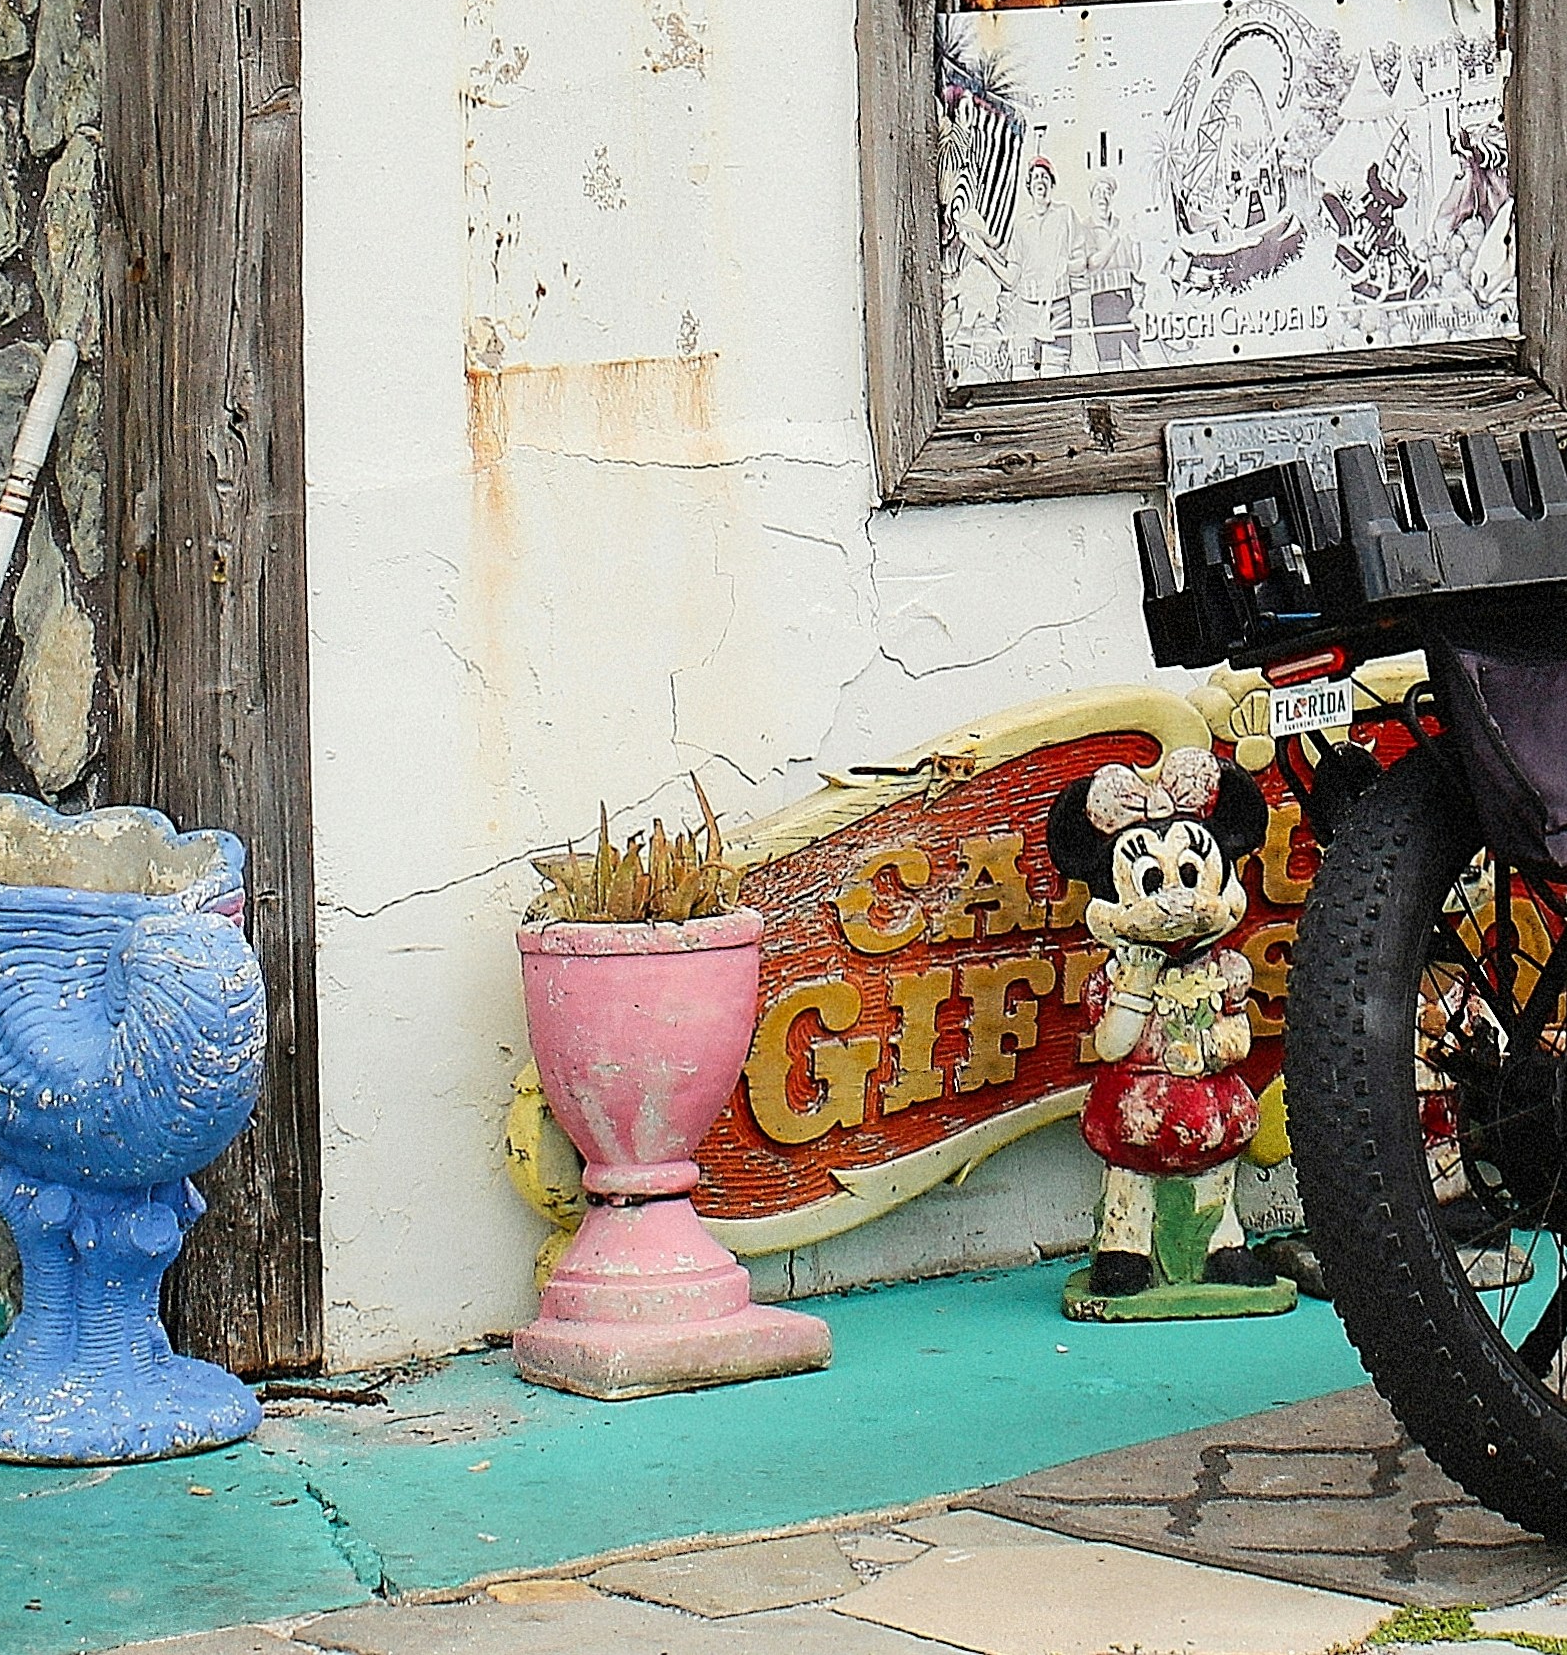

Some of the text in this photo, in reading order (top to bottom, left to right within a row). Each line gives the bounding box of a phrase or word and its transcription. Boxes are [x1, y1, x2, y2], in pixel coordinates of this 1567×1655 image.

[1140, 304, 1329, 343] BUSCH GARDENS
[1275, 689, 1347, 724] FLORIDA
